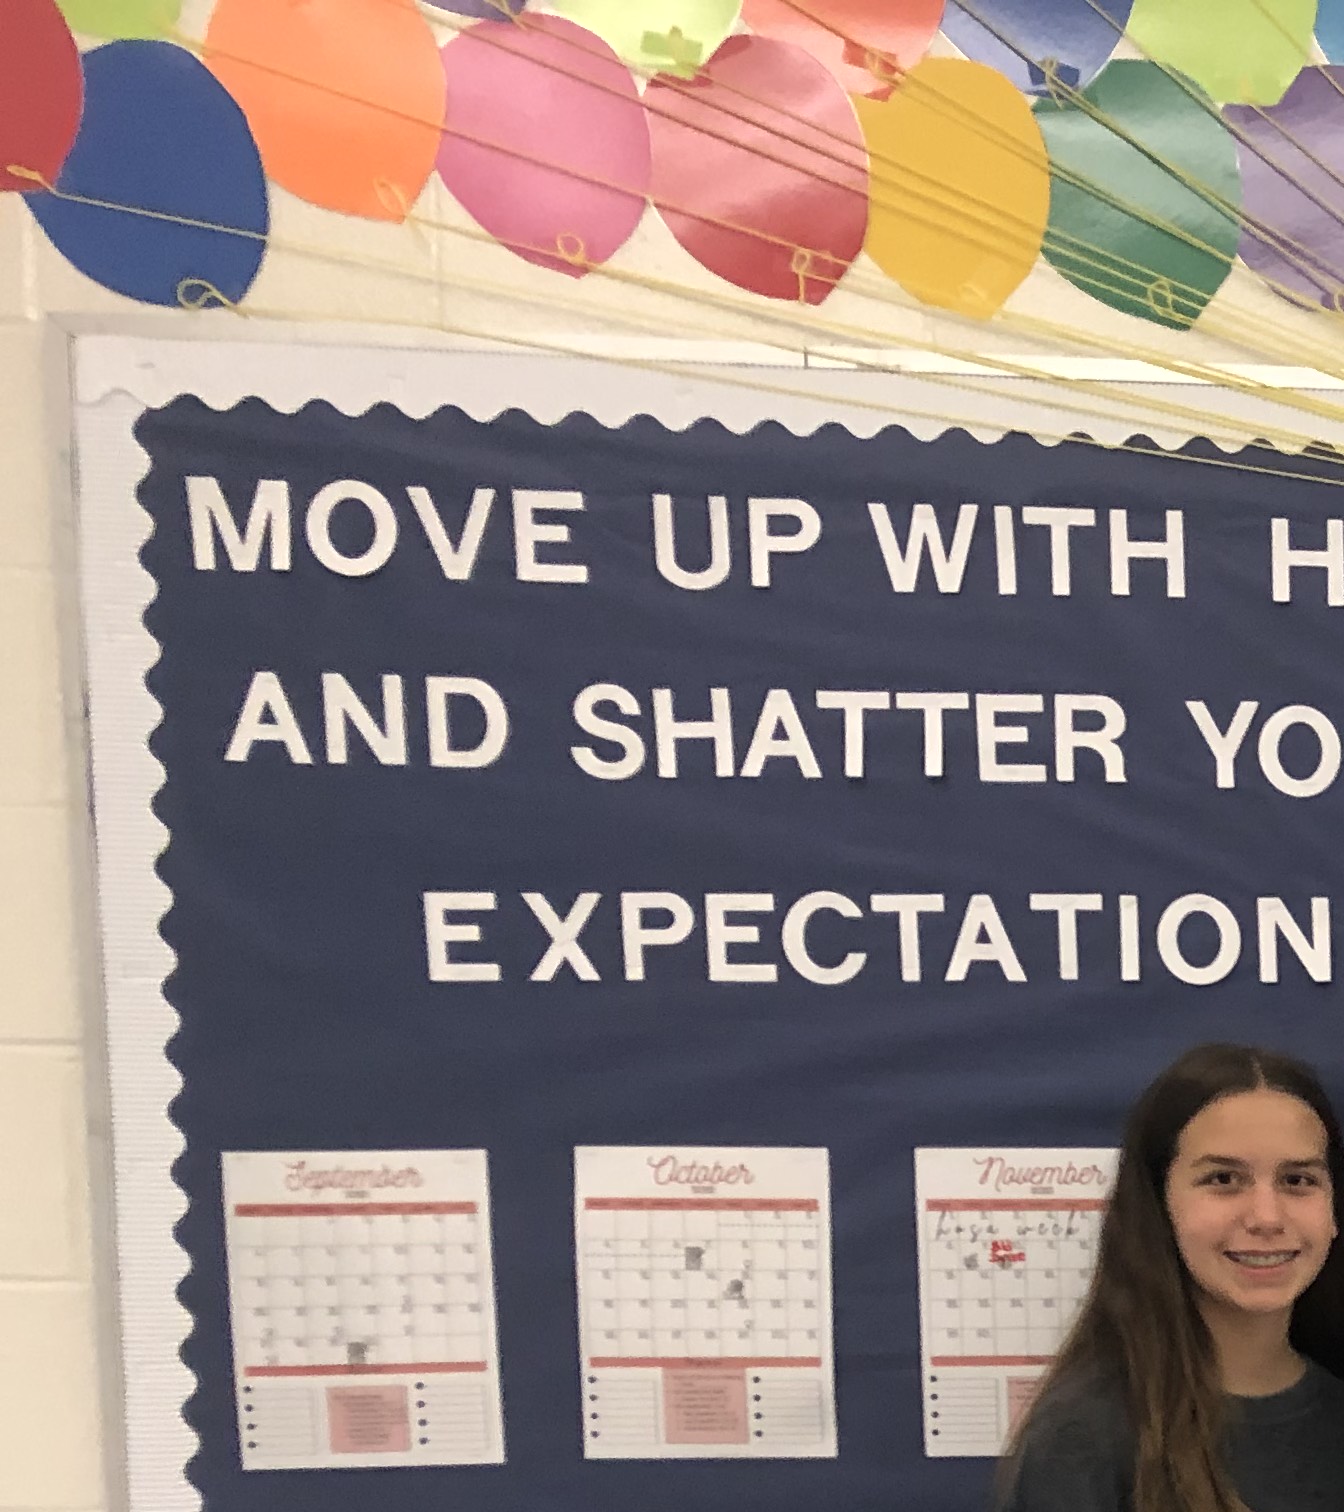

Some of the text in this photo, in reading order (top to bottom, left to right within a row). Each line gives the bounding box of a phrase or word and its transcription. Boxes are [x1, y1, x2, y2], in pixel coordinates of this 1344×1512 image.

[184, 475, 590, 584] MOVE
[652, 493, 823, 592] UP
[867, 502, 1187, 599] WITH
[224, 671, 509, 769] AND
[570, 683, 1128, 784] SHATTER
[646, 1155, 755, 1186] October
[972, 1156, 1107, 1192] November
